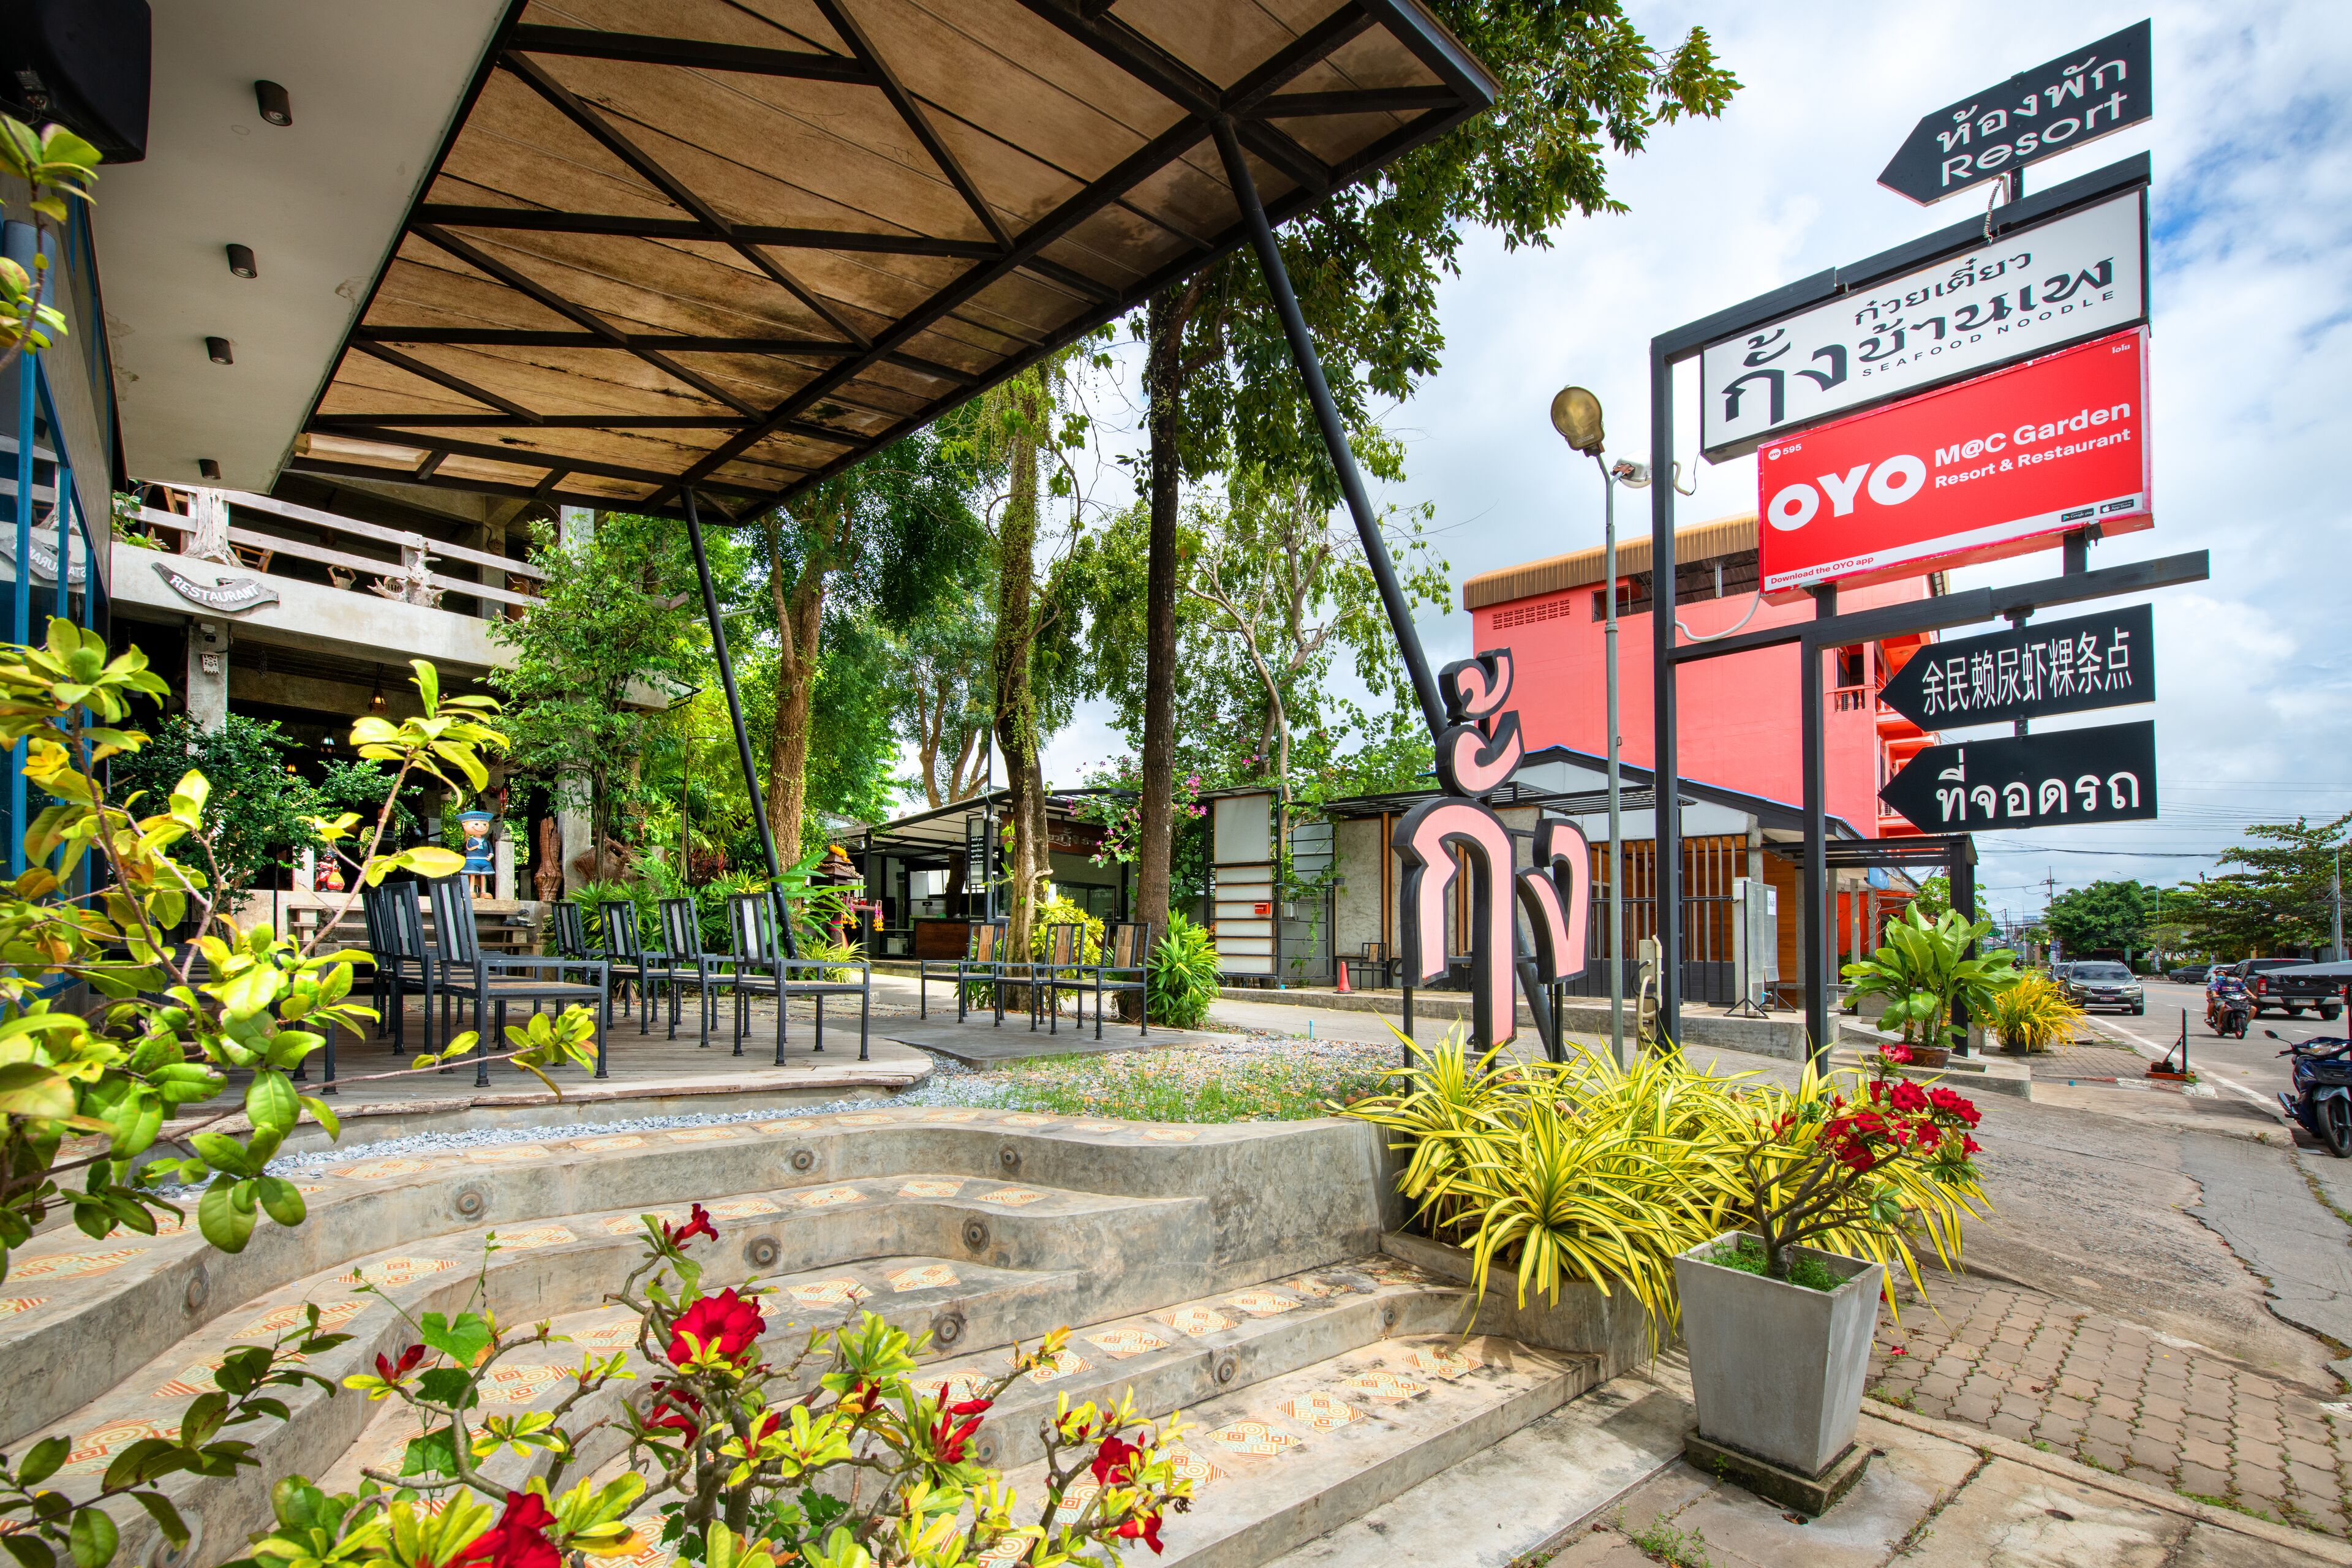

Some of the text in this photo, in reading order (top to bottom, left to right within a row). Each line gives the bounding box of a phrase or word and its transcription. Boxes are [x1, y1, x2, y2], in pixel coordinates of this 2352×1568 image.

[1936, 56, 2127, 153] ห้องพัก
[1942, 91, 2127, 187] Resort
[1855, 252, 2032, 326] ก๋วยเตี๋ยว
[1862, 291, 2114, 377] SEAFOOD NOODLE
[2112, 343, 2130, 354] โอโย
[1783, 443, 1802, 455] 595
[1935, 402, 2131, 467] M@C Garden
[1935, 428, 2131, 488] Resort & Restaurant
[1767, 454, 1927, 532] OYO
[169, 574, 260, 603] RESTAURANT
[1771, 557, 1874, 584] Download the OYO app
[1922, 627, 2133, 716] 余民赖尿虾粿条点
[1936, 749, 2140, 823] ที่จอดรถ
